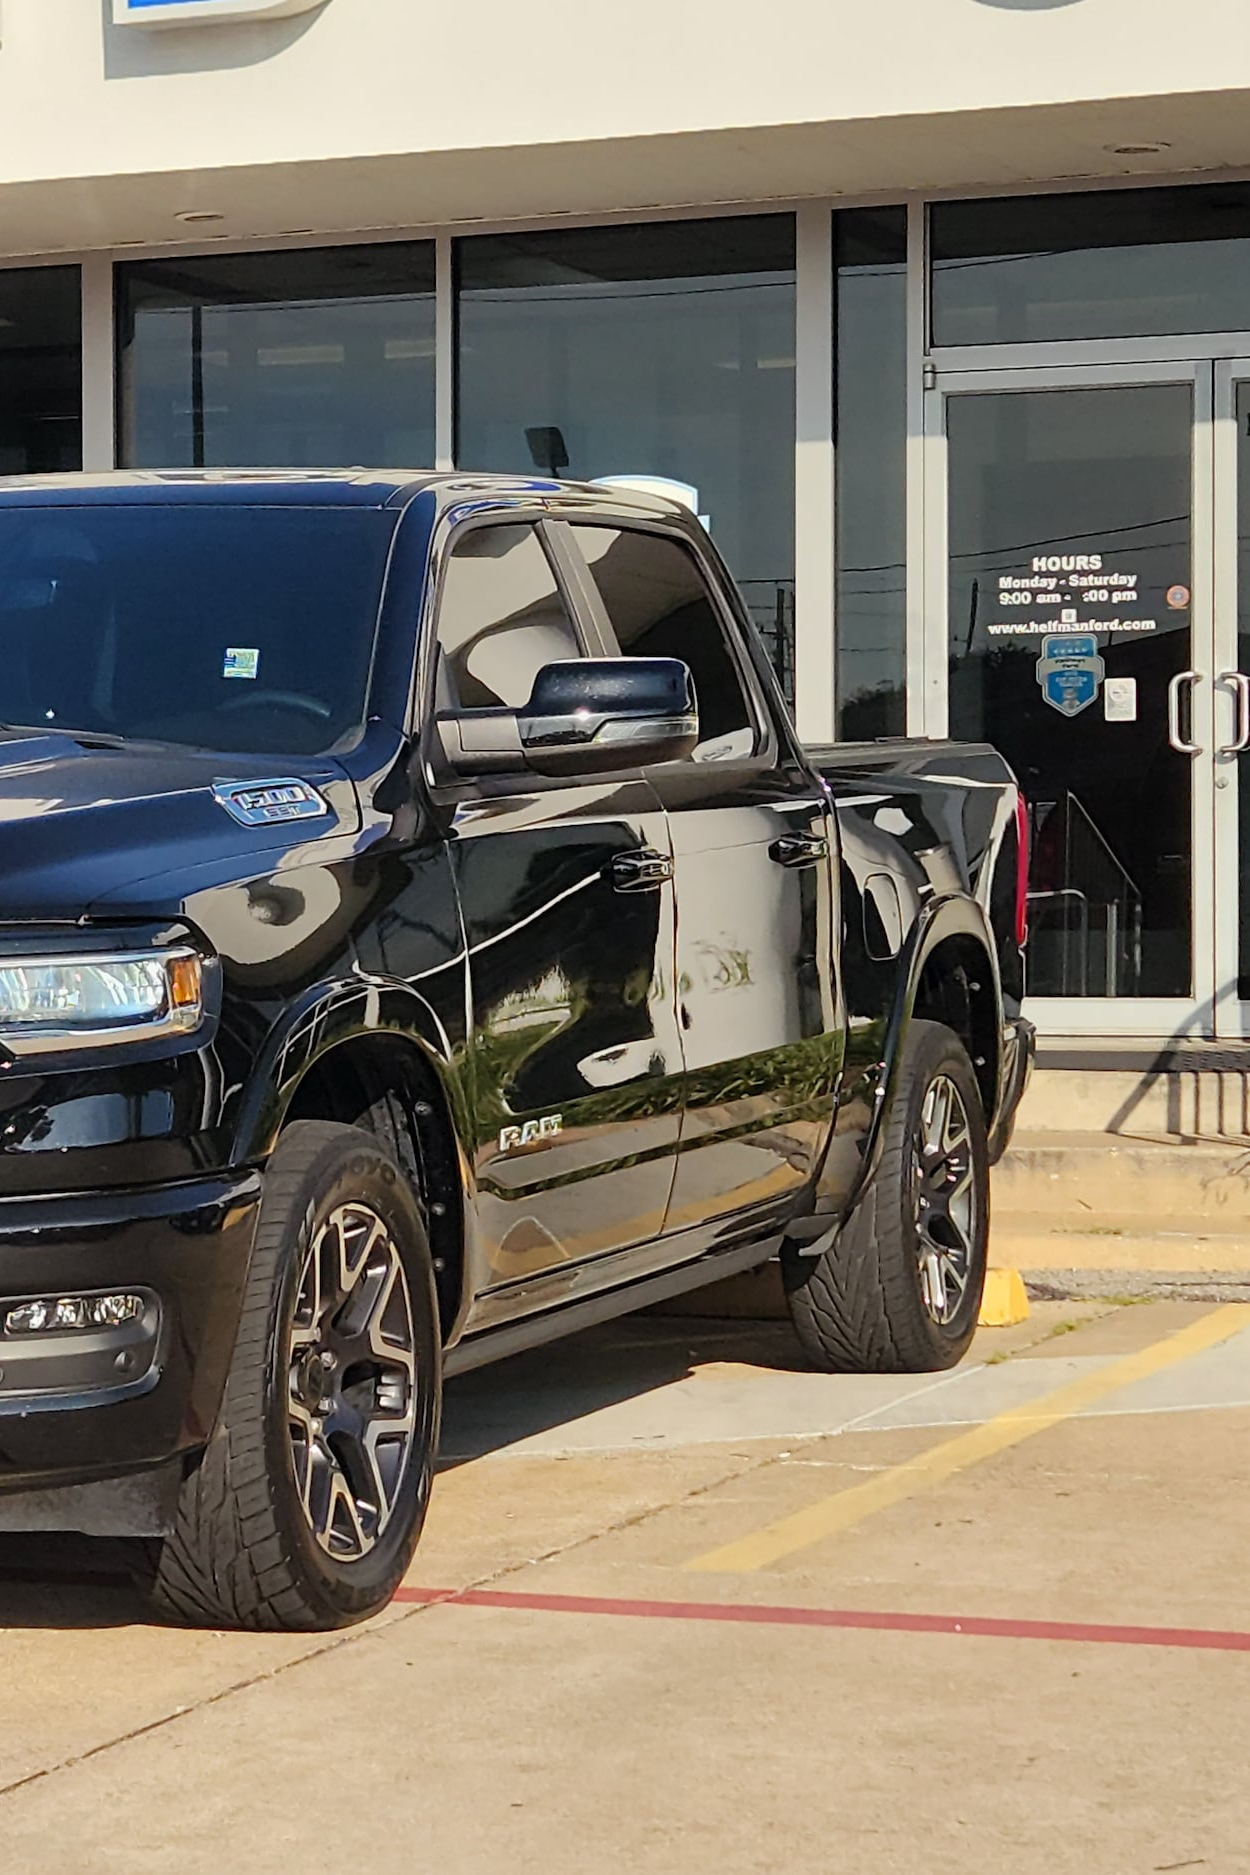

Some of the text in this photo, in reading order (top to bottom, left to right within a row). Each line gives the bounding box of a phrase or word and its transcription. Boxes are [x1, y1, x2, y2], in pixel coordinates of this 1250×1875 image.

[1032, 555, 1102, 572] HOURS
[999, 577, 1057, 590] Monday
[1068, 573, 1137, 588] Saturday
[999, 591, 1032, 605] 9:00
[1036, 592, 1062, 604] am
[1112, 589, 1138, 604] pm
[987, 618, 1156, 635] www.helfmanford.com
[237, 786, 306, 810] 1500
[499, 1113, 563, 1152] RAM
